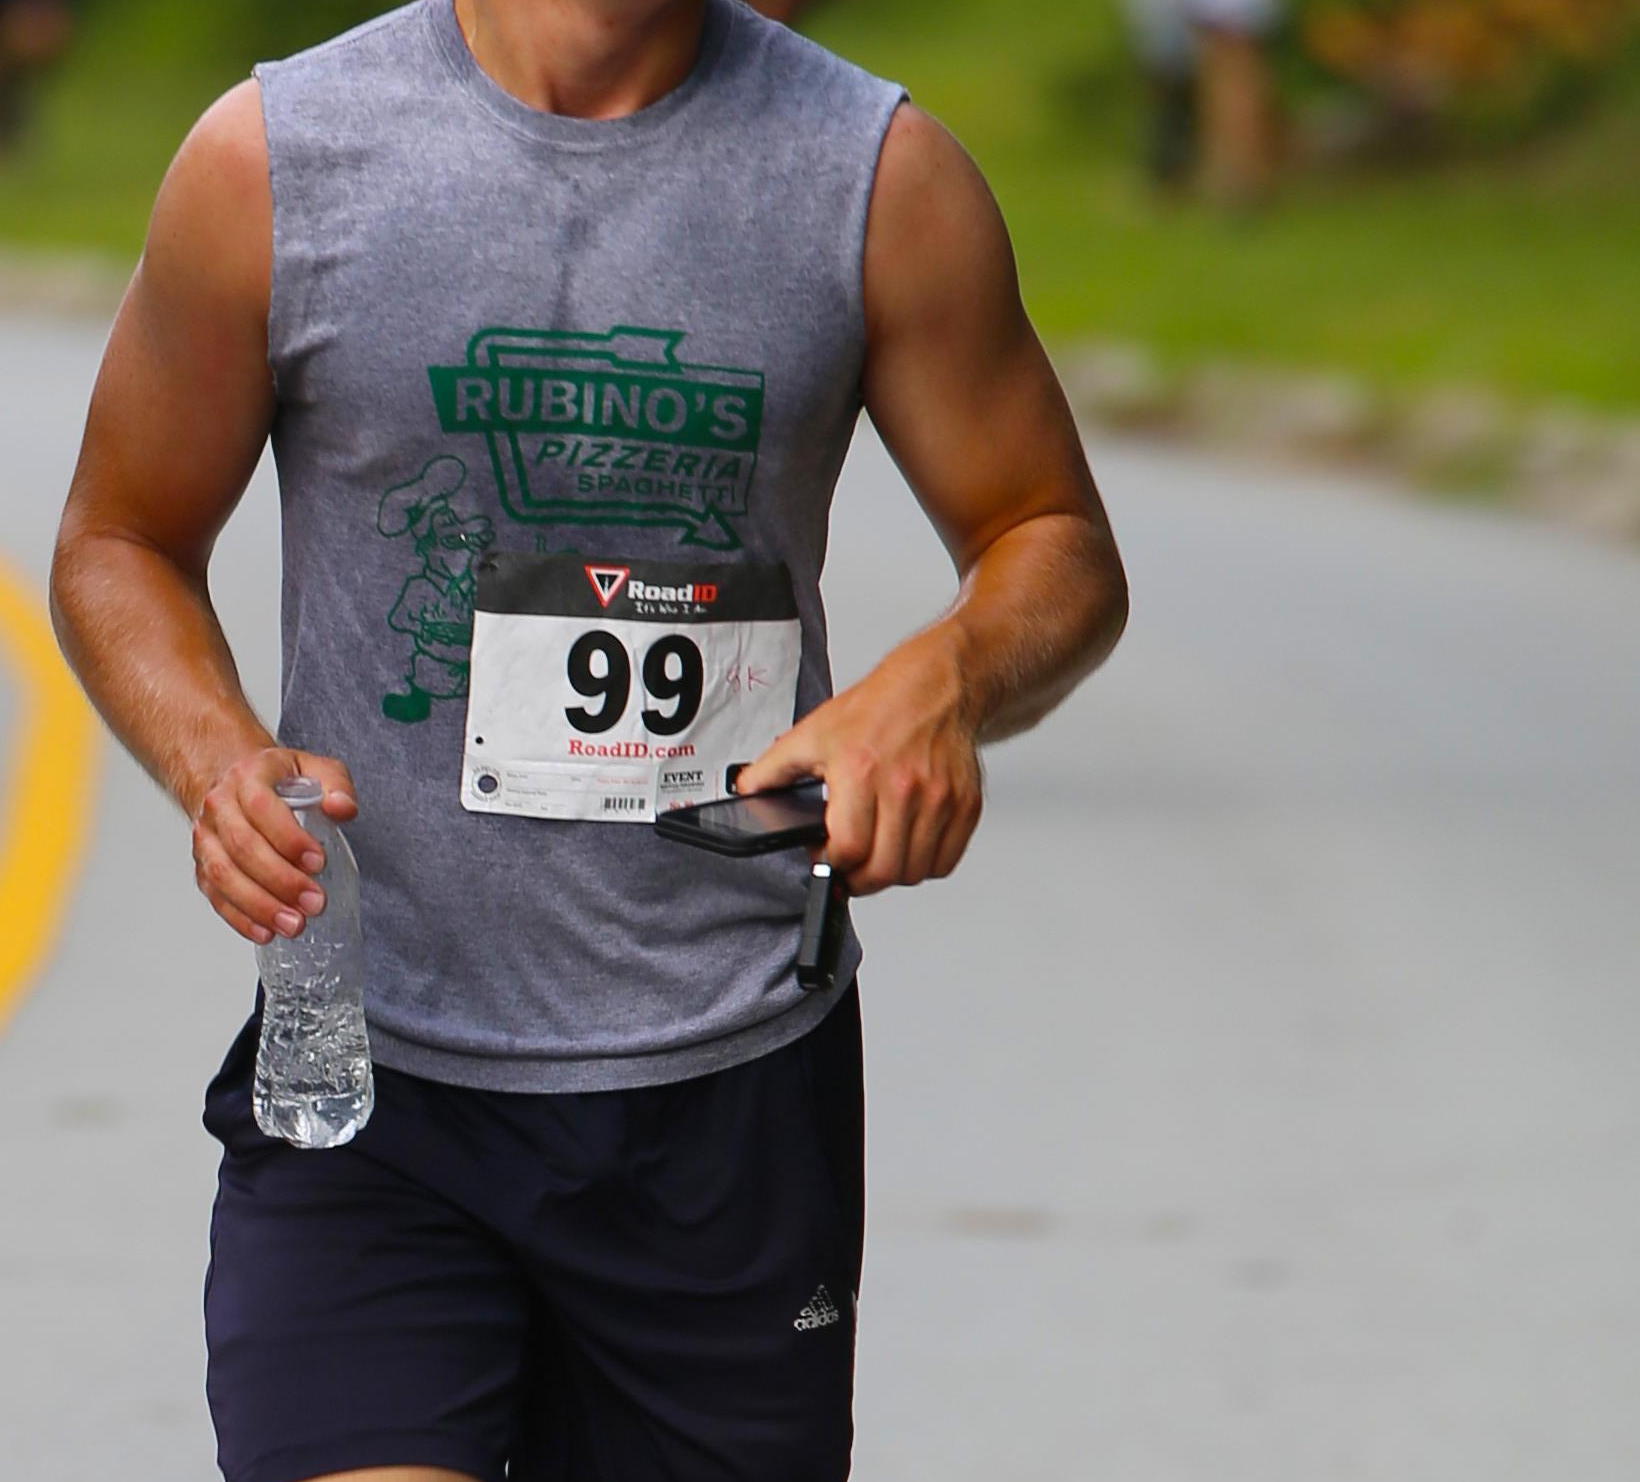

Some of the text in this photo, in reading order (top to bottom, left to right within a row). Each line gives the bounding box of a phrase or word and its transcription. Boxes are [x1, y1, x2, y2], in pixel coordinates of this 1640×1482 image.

[455, 375, 749, 440] RUBINO'S
[535, 440, 743, 480] PIZZERIA
[577, 474, 737, 504] SPAGHETTI
[627, 580, 718, 603] RoadID
[564, 629, 704, 736] 99
[568, 739, 695, 759] RoadID.com
[663, 770, 703, 783] EVENT
